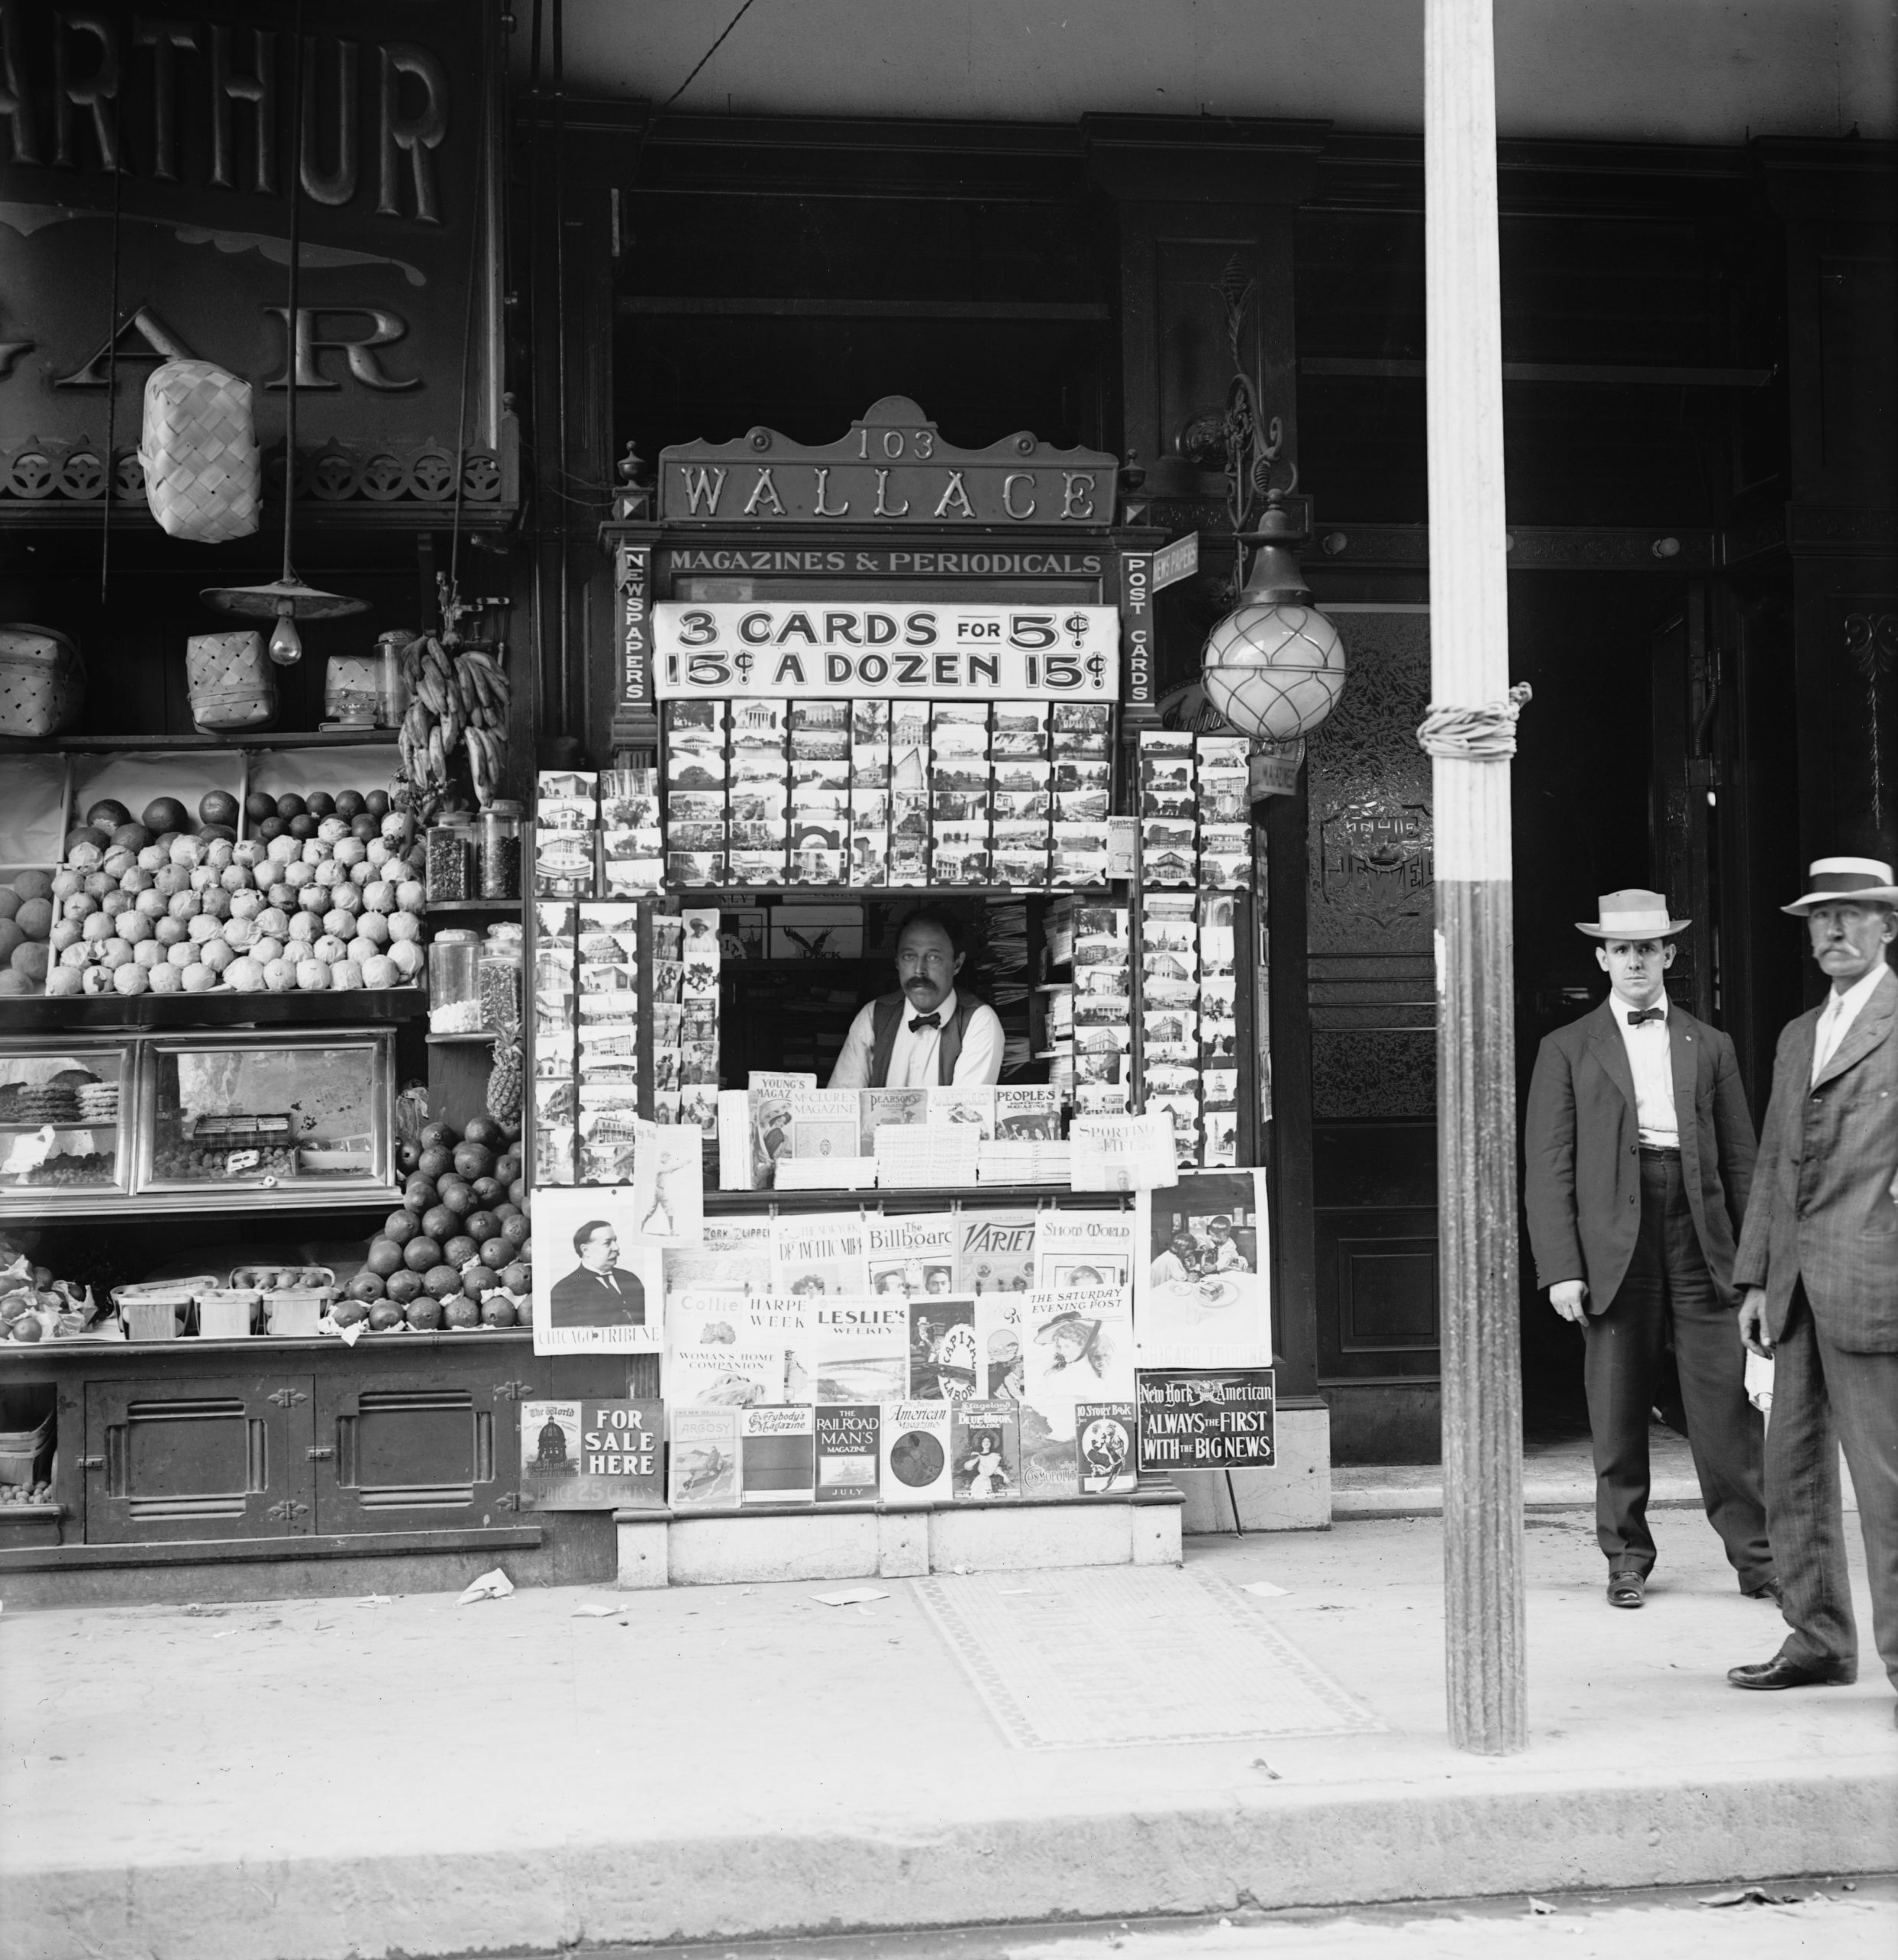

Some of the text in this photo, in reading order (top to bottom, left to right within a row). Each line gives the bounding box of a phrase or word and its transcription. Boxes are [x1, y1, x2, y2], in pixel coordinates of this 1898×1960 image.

[0, 305, 423, 389] AR
[858, 428, 935, 460] 103
[680, 466, 1096, 519] WALLACE
[670, 550, 1102, 573] MAGAZINES & PERIODICALS
[625, 554, 645, 699] NEWSPAPERS
[678, 611, 1090, 651] 3 CARDS FOR 5¢
[1128, 559, 1148, 701] POST CARDS
[665, 651, 1108, 690] 15¢ A DOZEN 15¢
[762, 1078, 805, 1089] YOUNG'S
[997, 1090, 1056, 1102] PEOPLE'S
[795, 1103, 857, 1115] MAGAZINE
[1079, 1122, 1155, 1138] SPORTING
[905, 1221, 923, 1233] The
[681, 1295, 740, 1312] Collie
[1030, 1289, 1123, 1304] THE SATURDAY
[1031, 1299, 1124, 1314] EVENING POST
[818, 1309, 906, 1325] LESLIE'S
[538, 1326, 661, 1345] CHICAGO TRIBUNE
[833, 1327, 894, 1335] WEEKLY
[688, 1361, 765, 1370] COMPANION
[1140, 1382, 1165, 1403] New
[1216, 1381, 1272, 1402] American
[749, 1411, 805, 1425] Everybody's
[887, 1404, 946, 1420] American
[1076, 1406, 1086, 1417] 10
[596, 1410, 644, 1430] FOR
[749, 1421, 805, 1433] Magazine
[816, 1417, 879, 1431] RAILROAD
[1147, 1412, 1205, 1435] ALWAYS
[1220, 1411, 1268, 1432] FIRST
[679, 1423, 731, 1435] ARGOSY
[584, 1432, 656, 1452] SALE
[821, 1431, 874, 1445] MAN'S
[1143, 1438, 1180, 1460] WITH
[1195, 1437, 1223, 1459] BIG
[1225, 1436, 1271, 1459] NEWS
[589, 1455, 655, 1476] HERE
[536, 1481, 645, 1502] PRICE 25 CENTS
